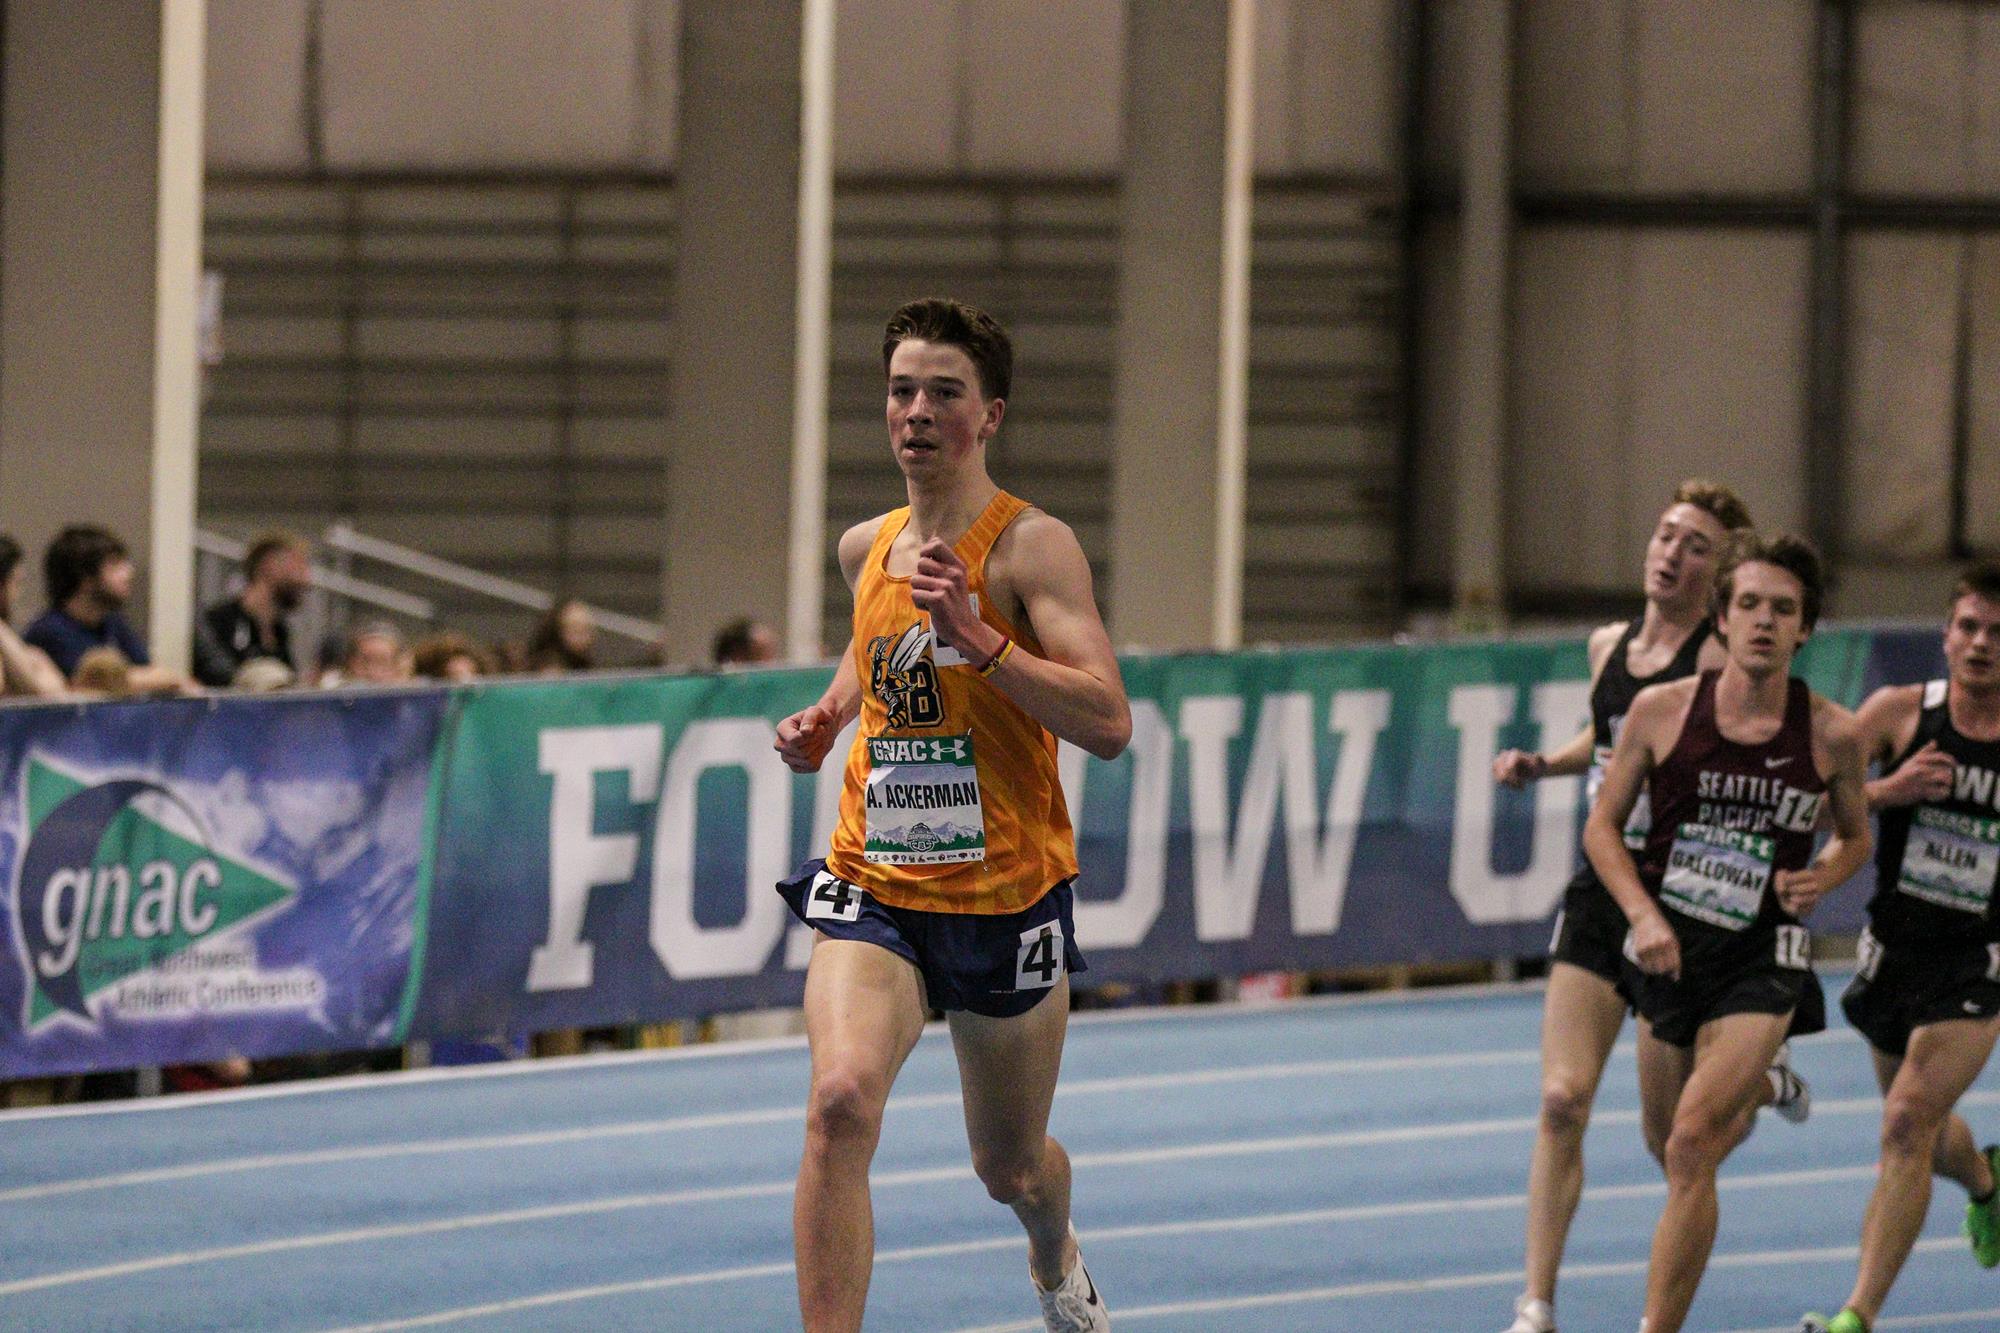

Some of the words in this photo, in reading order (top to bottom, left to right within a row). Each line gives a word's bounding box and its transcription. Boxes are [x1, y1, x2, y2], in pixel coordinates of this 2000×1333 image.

[872, 739, 927, 761] GNAC
[867, 783, 882, 808] A.
[886, 781, 978, 809] ACKERMAN
[1698, 770, 1783, 806] SEATTLE
[1698, 803, 1774, 832] PACIFIC
[526, 692, 1392, 992] FOOW
[1924, 841, 1978, 870] ALLEN
[1672, 850, 1765, 890] GALLOWAY
[812, 878, 855, 914] 4
[37, 857, 221, 977] gnac
[1022, 927, 1057, 982] 4
